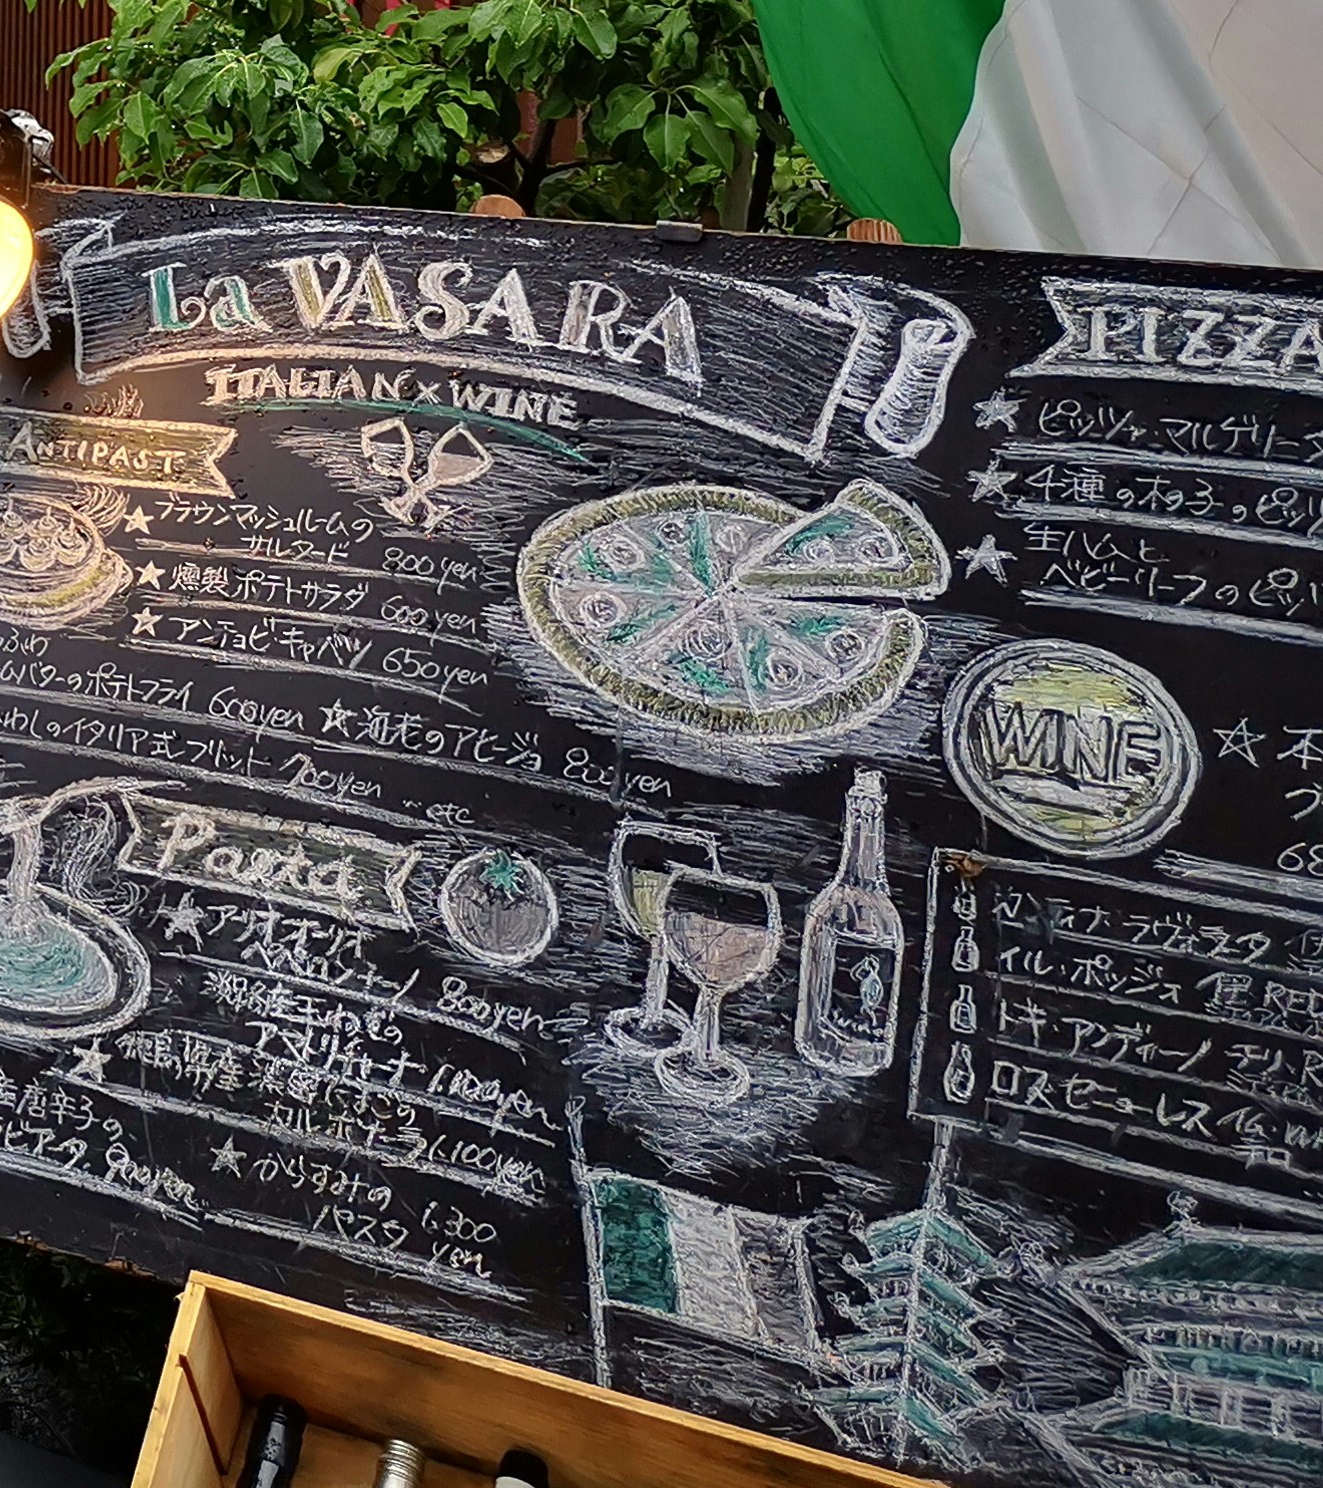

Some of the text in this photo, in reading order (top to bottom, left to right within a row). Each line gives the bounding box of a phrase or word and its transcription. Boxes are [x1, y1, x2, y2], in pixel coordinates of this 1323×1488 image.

[142, 250, 704, 382] La VASARA
[448, 380, 585, 430] WINE
[153, 492, 375, 544] ブラウンマッシュルームの
[1024, 522, 1170, 564] 生ハムと
[383, 546, 433, 577] 800
[355, 708, 542, 771] 海老のアヒージョ
[977, 702, 1161, 780] WINE
